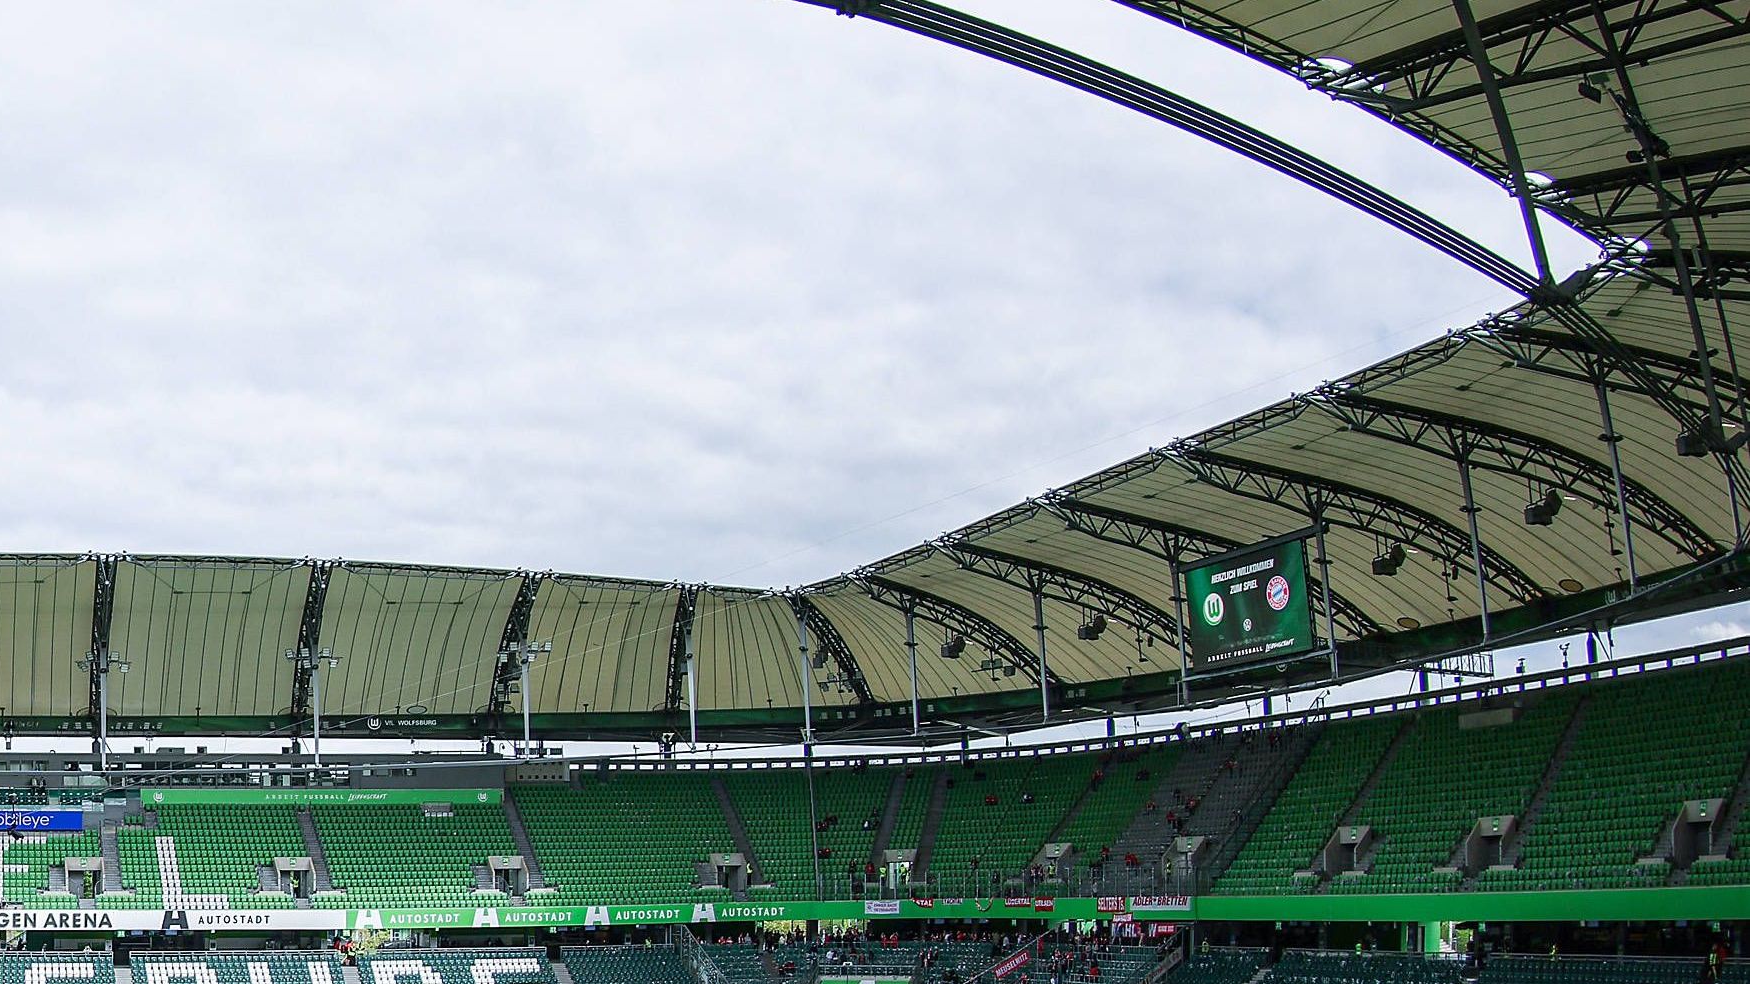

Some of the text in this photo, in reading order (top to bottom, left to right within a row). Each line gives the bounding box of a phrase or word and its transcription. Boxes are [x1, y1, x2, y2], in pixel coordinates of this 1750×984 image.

[1230, 579, 1258, 595] ZUM SPIEL
[1157, 896, 1188, 906] BRETTEN
[505, 912, 572, 923] AUTOSTADT
[616, 909, 680, 921] AUTOSTADT
[721, 907, 785, 918] AUTOSTADT
[43, 912, 113, 929] ARENA
[198, 915, 271, 925] AUTOSTADT
[390, 914, 460, 925] AUTOSTADT
[995, 951, 1029, 978] MEUSELWITZ
